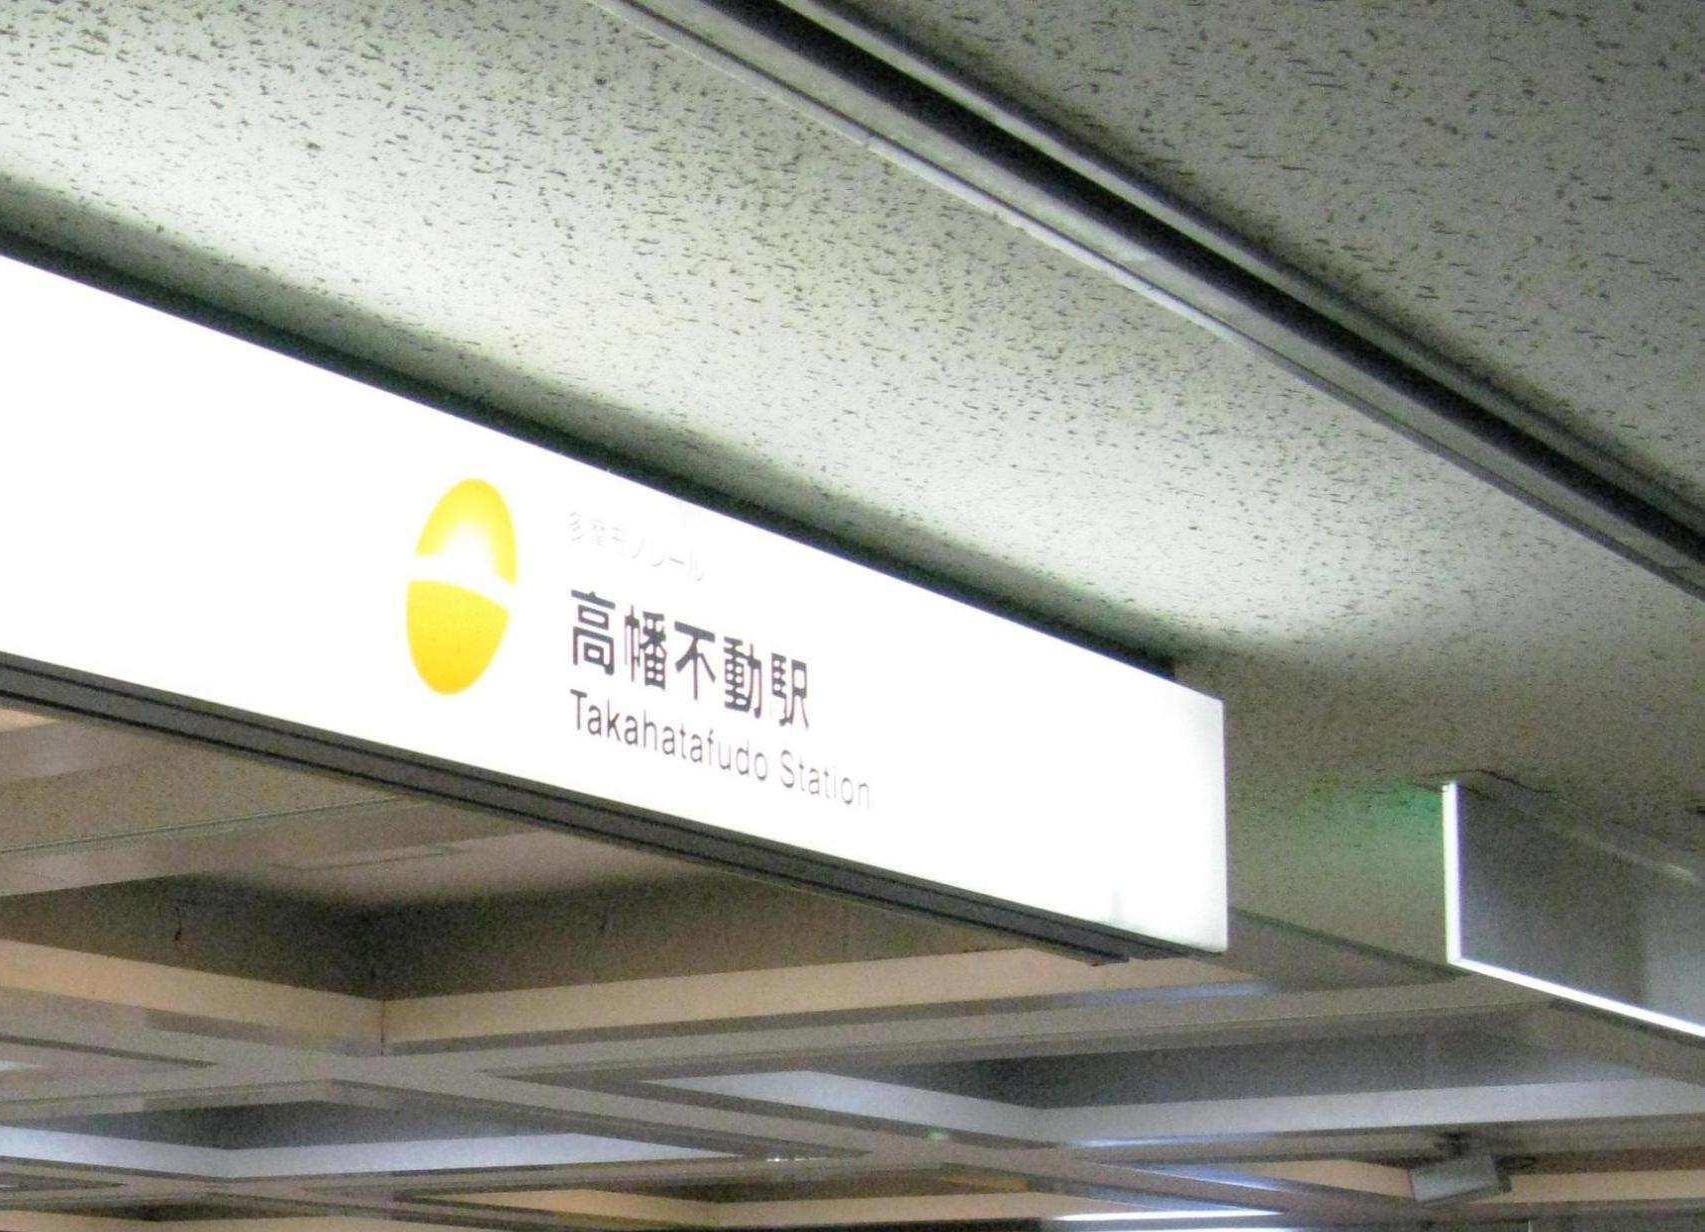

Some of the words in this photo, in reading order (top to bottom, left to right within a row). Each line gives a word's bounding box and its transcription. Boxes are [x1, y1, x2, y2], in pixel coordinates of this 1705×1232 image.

[570, 588, 810, 731] 高幡不動駅
[569, 688, 769, 782] Takahatafudo
[780, 749, 872, 809] Station
